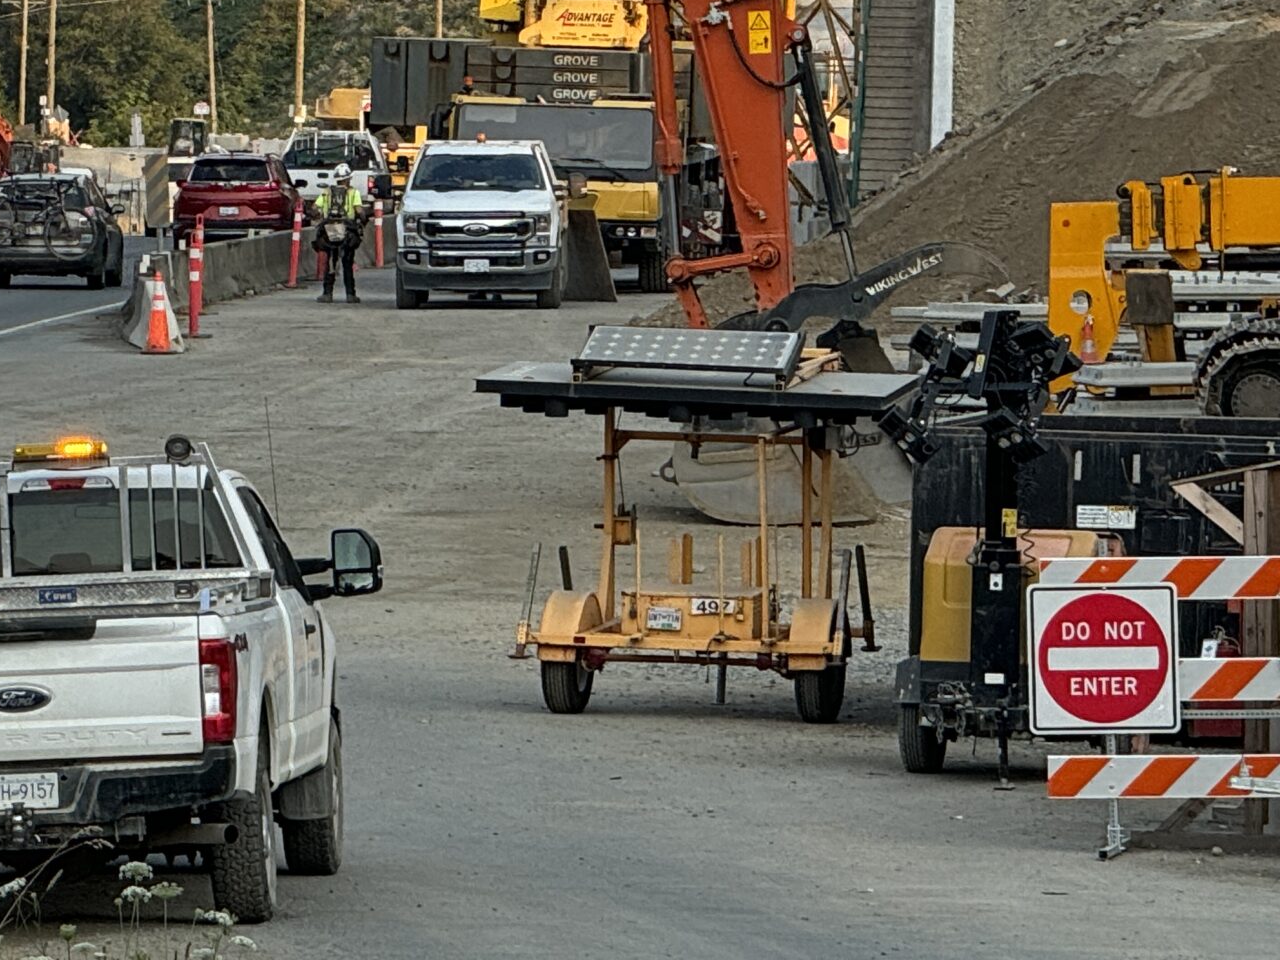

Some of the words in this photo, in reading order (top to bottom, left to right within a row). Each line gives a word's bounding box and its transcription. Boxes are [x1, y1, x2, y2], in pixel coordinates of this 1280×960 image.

[555, 8, 616, 24] ADVANTAGE
[554, 55, 599, 66] GROVE
[553, 72, 598, 84] GROVE
[553, 89, 598, 100] GROVE
[865, 269, 909, 296] VIKING
[907, 252, 944, 276] WEST
[696, 600, 731, 615] 497
[1062, 621, 1090, 640] DO
[1104, 621, 1146, 640] NOT
[1070, 677, 1138, 696] ENTER
[40, 727, 148, 745] DUTY
